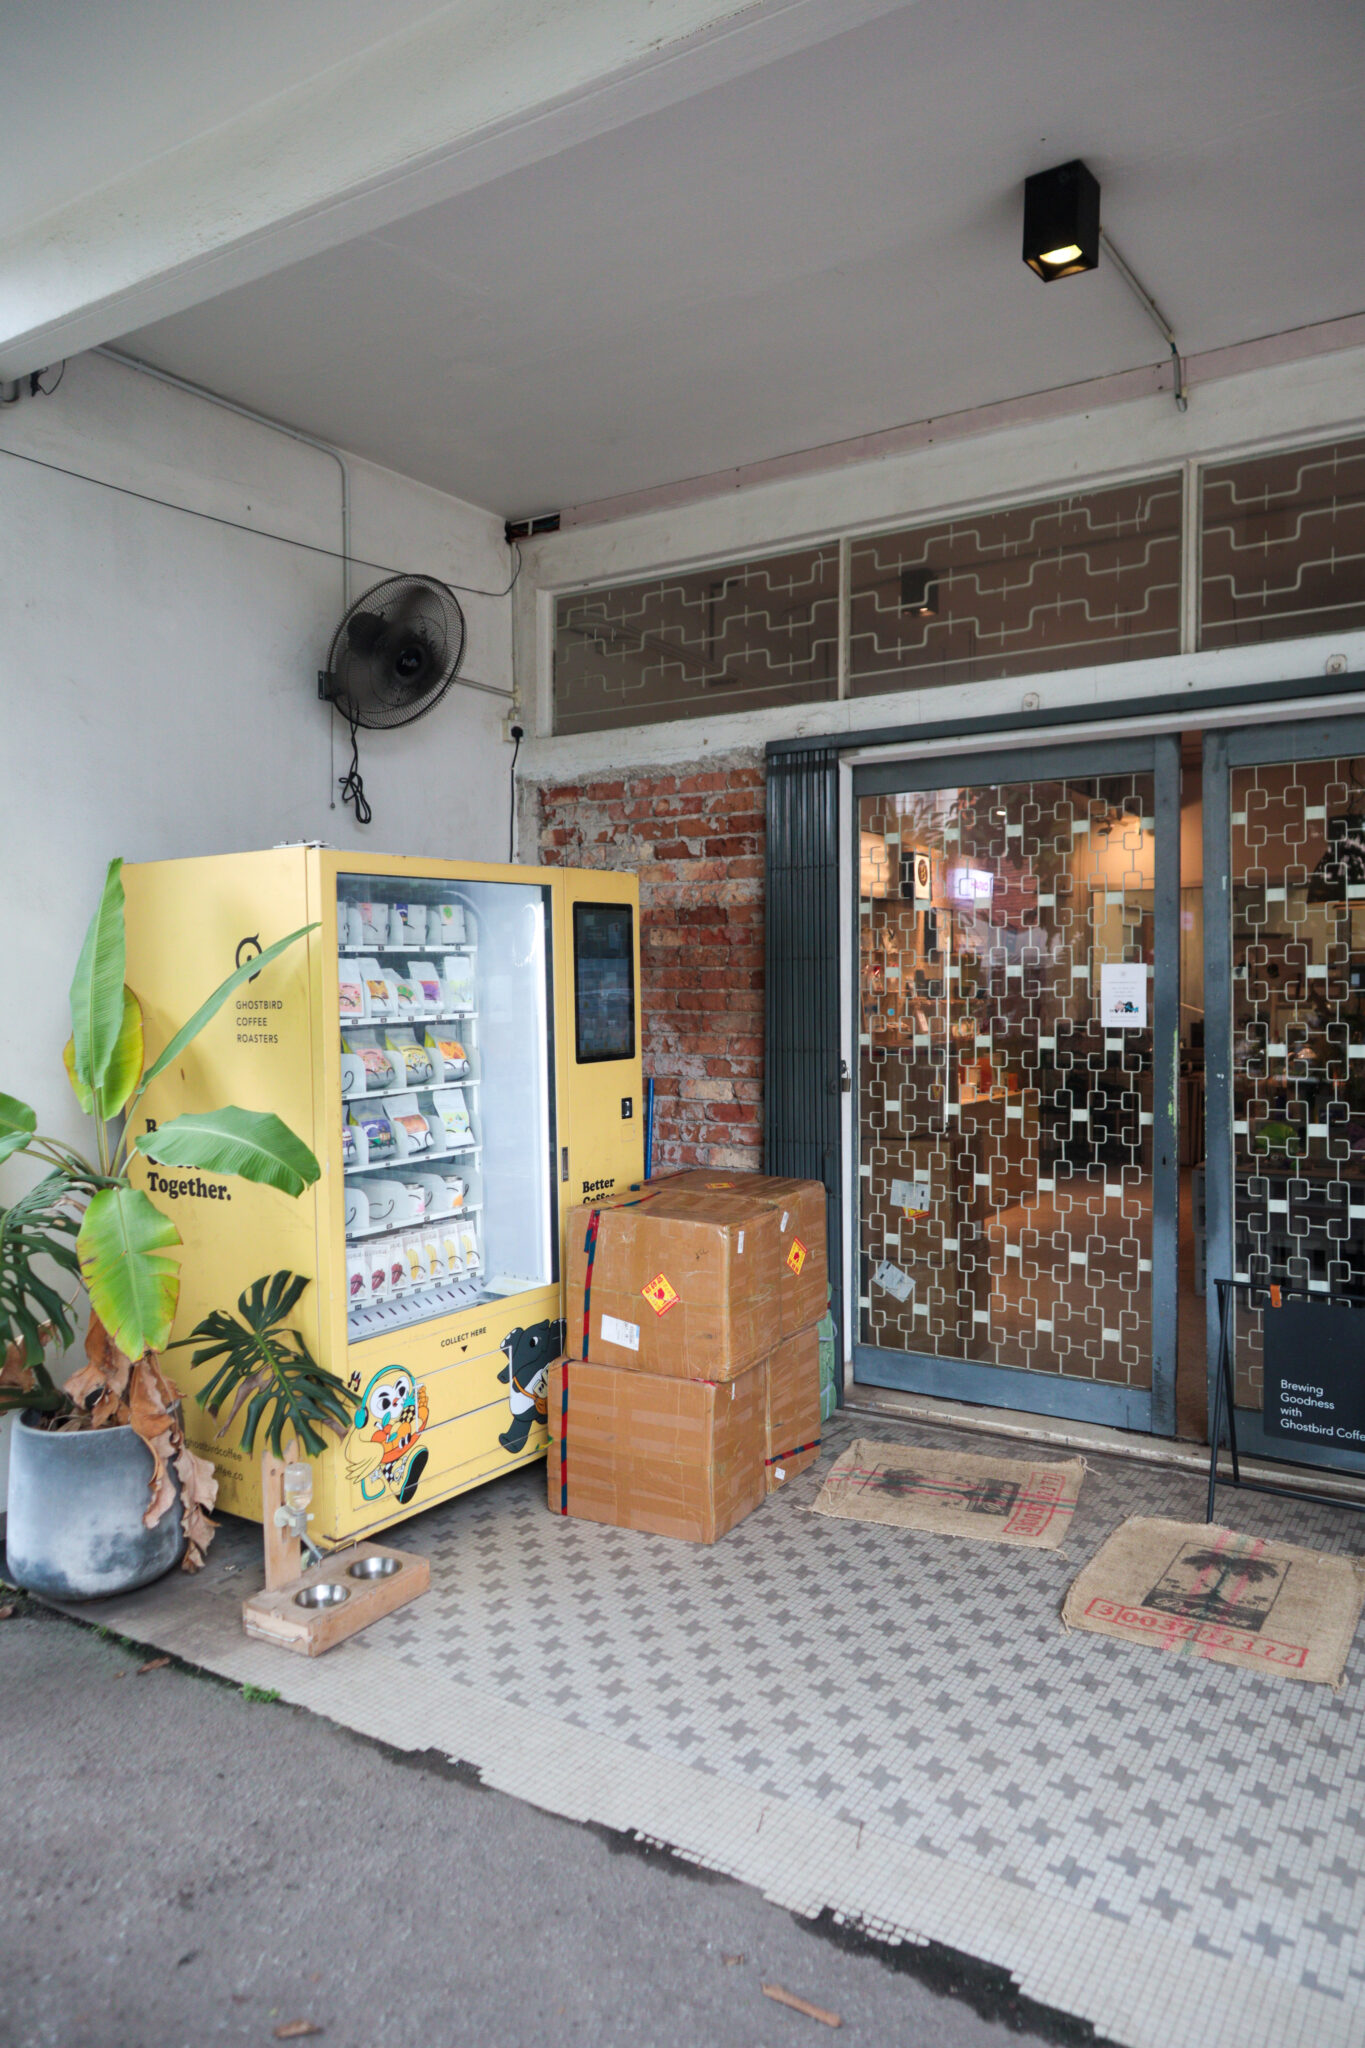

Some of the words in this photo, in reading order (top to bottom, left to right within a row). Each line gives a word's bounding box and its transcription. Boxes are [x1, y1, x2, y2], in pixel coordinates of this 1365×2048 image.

[235, 1000, 283, 1010] GHOSTBIRD
[236, 1017, 268, 1027] COFFEE
[236, 1033, 279, 1044] ROASTERS
[147, 1171, 232, 1201] Together.
[582, 1178, 615, 1194] Better
[440, 1332, 469, 1348] COLLECT
[470, 1326, 487, 1338] HERE
[1280, 1379, 1324, 1398] Brewing
[1280, 1392, 1335, 1410] Goodness
[1280, 1406, 1303, 1417] with
[1280, 1418, 1334, 1436] Ghostbird
[1099, 1604, 1114, 1616] 3
